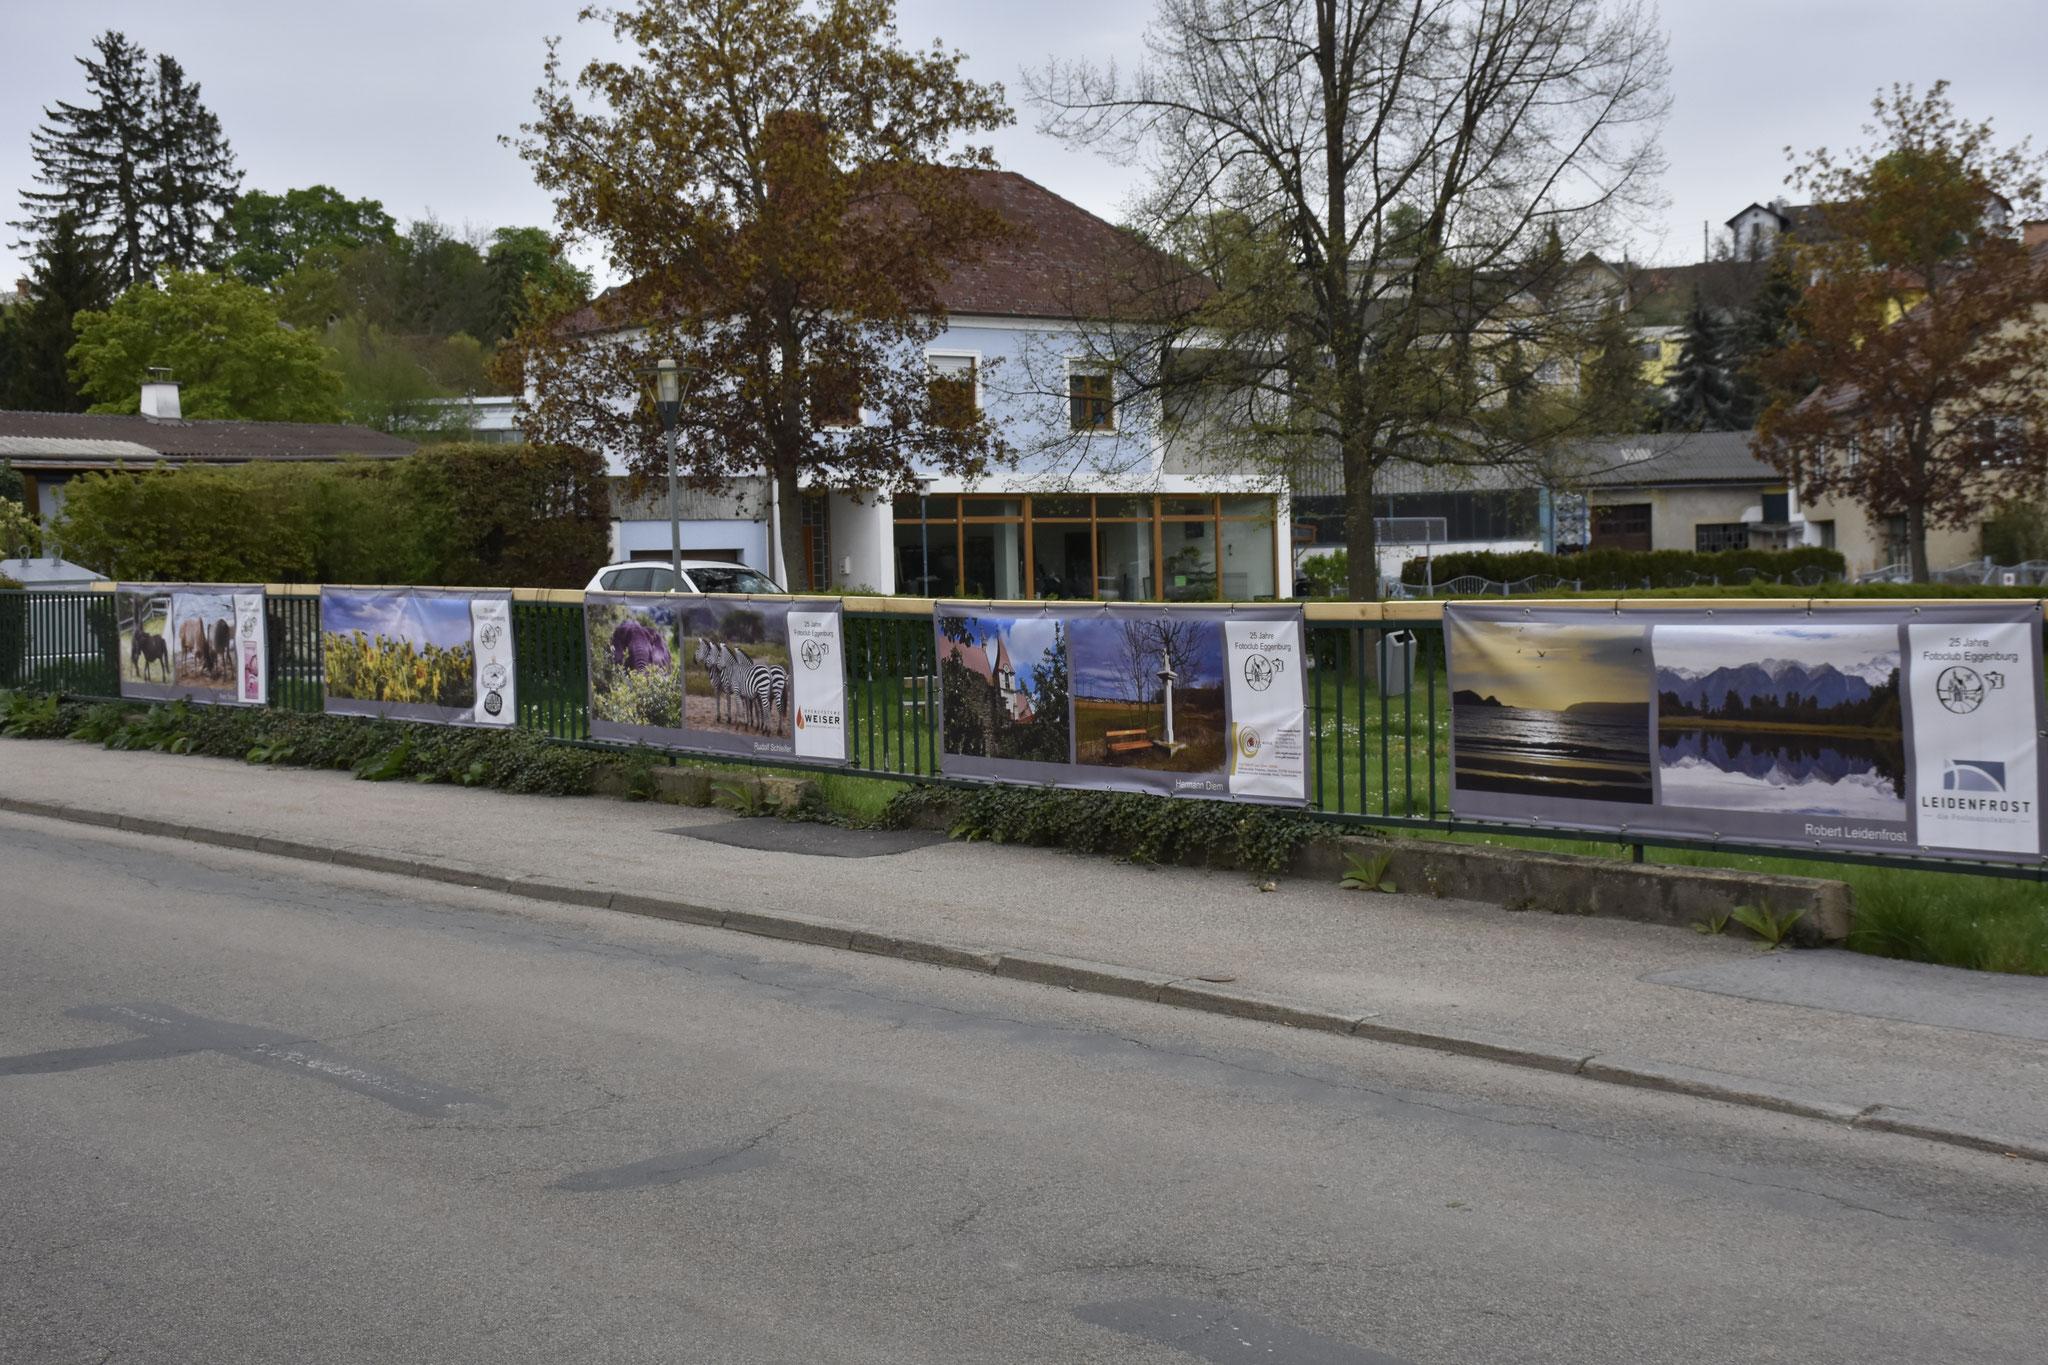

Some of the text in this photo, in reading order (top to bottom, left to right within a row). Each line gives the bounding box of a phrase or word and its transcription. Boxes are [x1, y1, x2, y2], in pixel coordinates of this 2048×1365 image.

[804, 620, 822, 628] 25 Jahre
[793, 629, 834, 638] Fotoclub Eggenburg
[1249, 632, 1275, 640] 25 Jahre
[1234, 642, 1292, 653] Fotoclub Eggenburg
[1949, 637, 1990, 648] 25 Jahre
[1923, 651, 2019, 664] Fotoclub Eggenburg
[804, 714, 840, 725] WEISER
[1175, 779, 1224, 791] Hermann Diem
[1922, 796, 2031, 813] LEIDENFROST
[1805, 823, 1908, 843] Robert Leidenfrost
